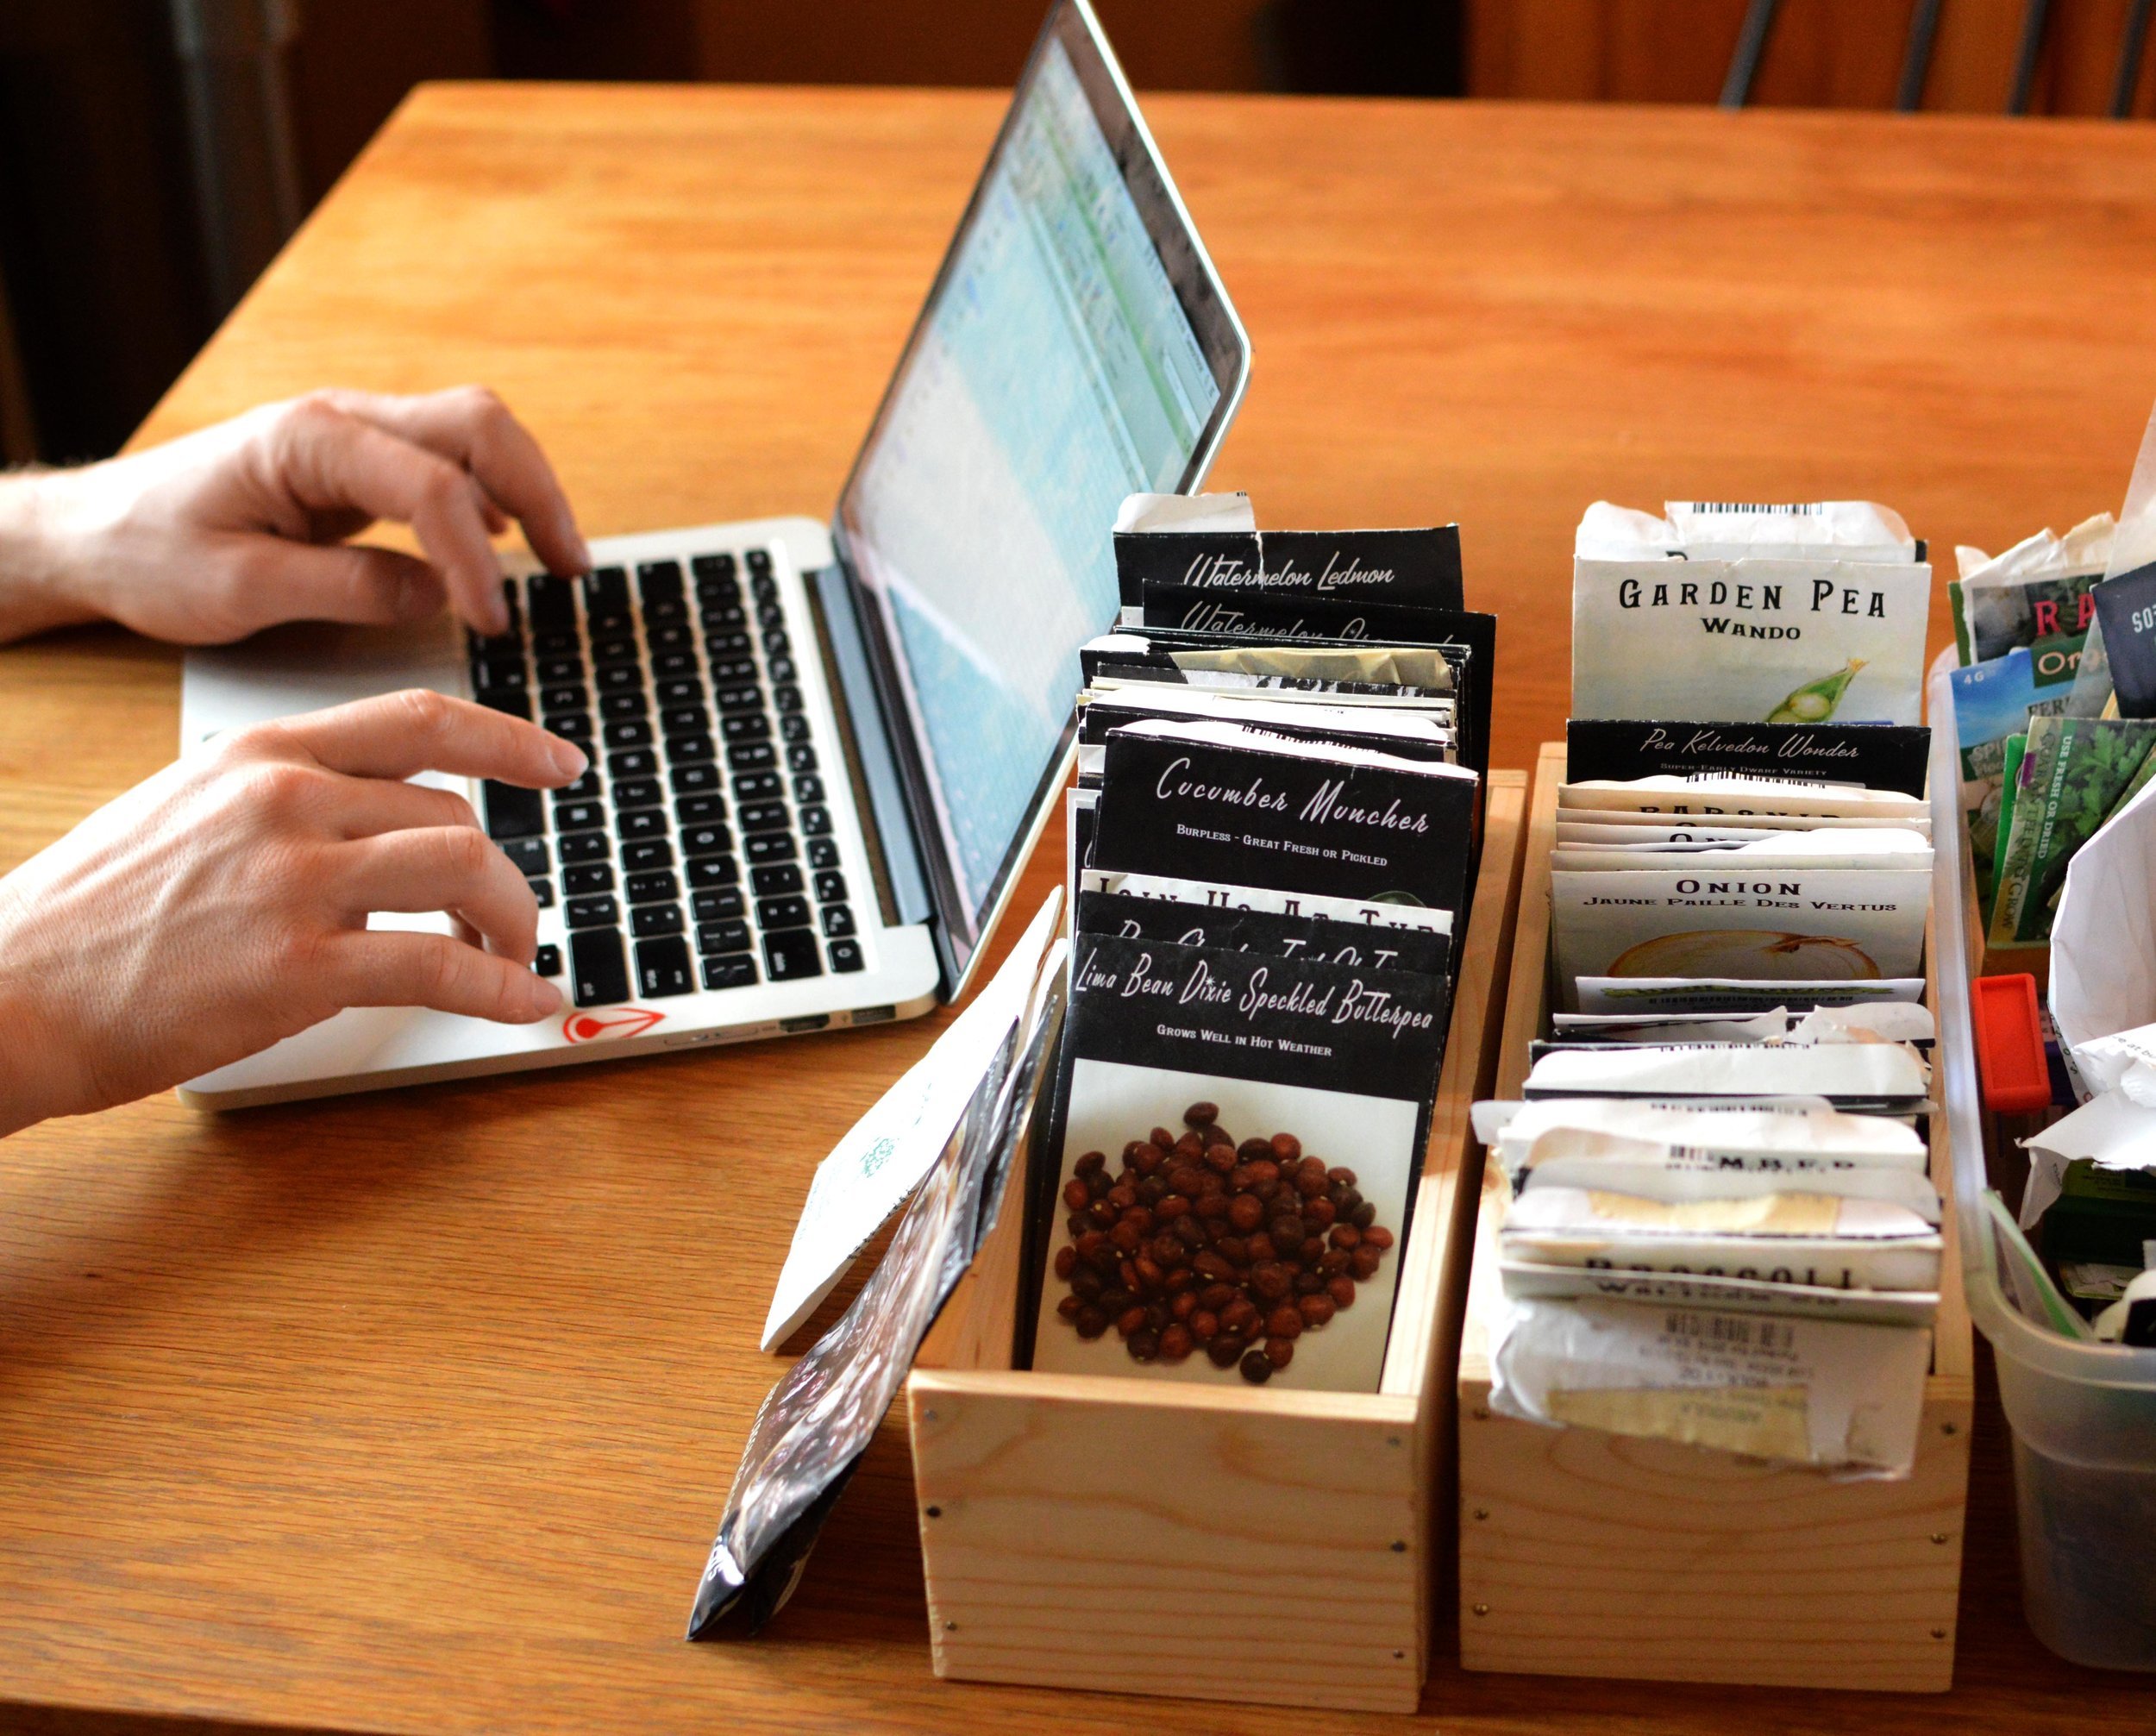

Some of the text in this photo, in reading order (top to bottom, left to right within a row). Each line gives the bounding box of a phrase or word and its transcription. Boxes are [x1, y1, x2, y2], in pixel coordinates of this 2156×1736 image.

[1183, 551, 1395, 590] Watermelon Ledmon
[1619, 579, 1885, 618] GARDEN PEA
[1702, 617, 1801, 640] WANDO
[1639, 728, 1859, 758] Pea Kelvedon Wonder
[2059, 736, 2072, 758] USE
[1156, 757, 1429, 833] Cucumber Muncher
[2050, 761, 2066, 798] FRESH
[1176, 824, 1231, 843] BURPLESS
[1243, 834, 1280, 850] GREAT
[1283, 840, 1319, 856] FRESH
[1322, 848, 1337, 860] OR
[1341, 849, 1388, 867] PICKLED
[2038, 822, 2053, 860] DRIED
[1583, 897, 1897, 912] JAUNE PAILLE DES VERTUS
[1677, 879, 1801, 895] ONION
[1075, 948, 1433, 1039] Lima Bean Dixie Speckled Butterpea
[1156, 1024, 1332, 1056] GROWS WELL IN HOT WEATHER
